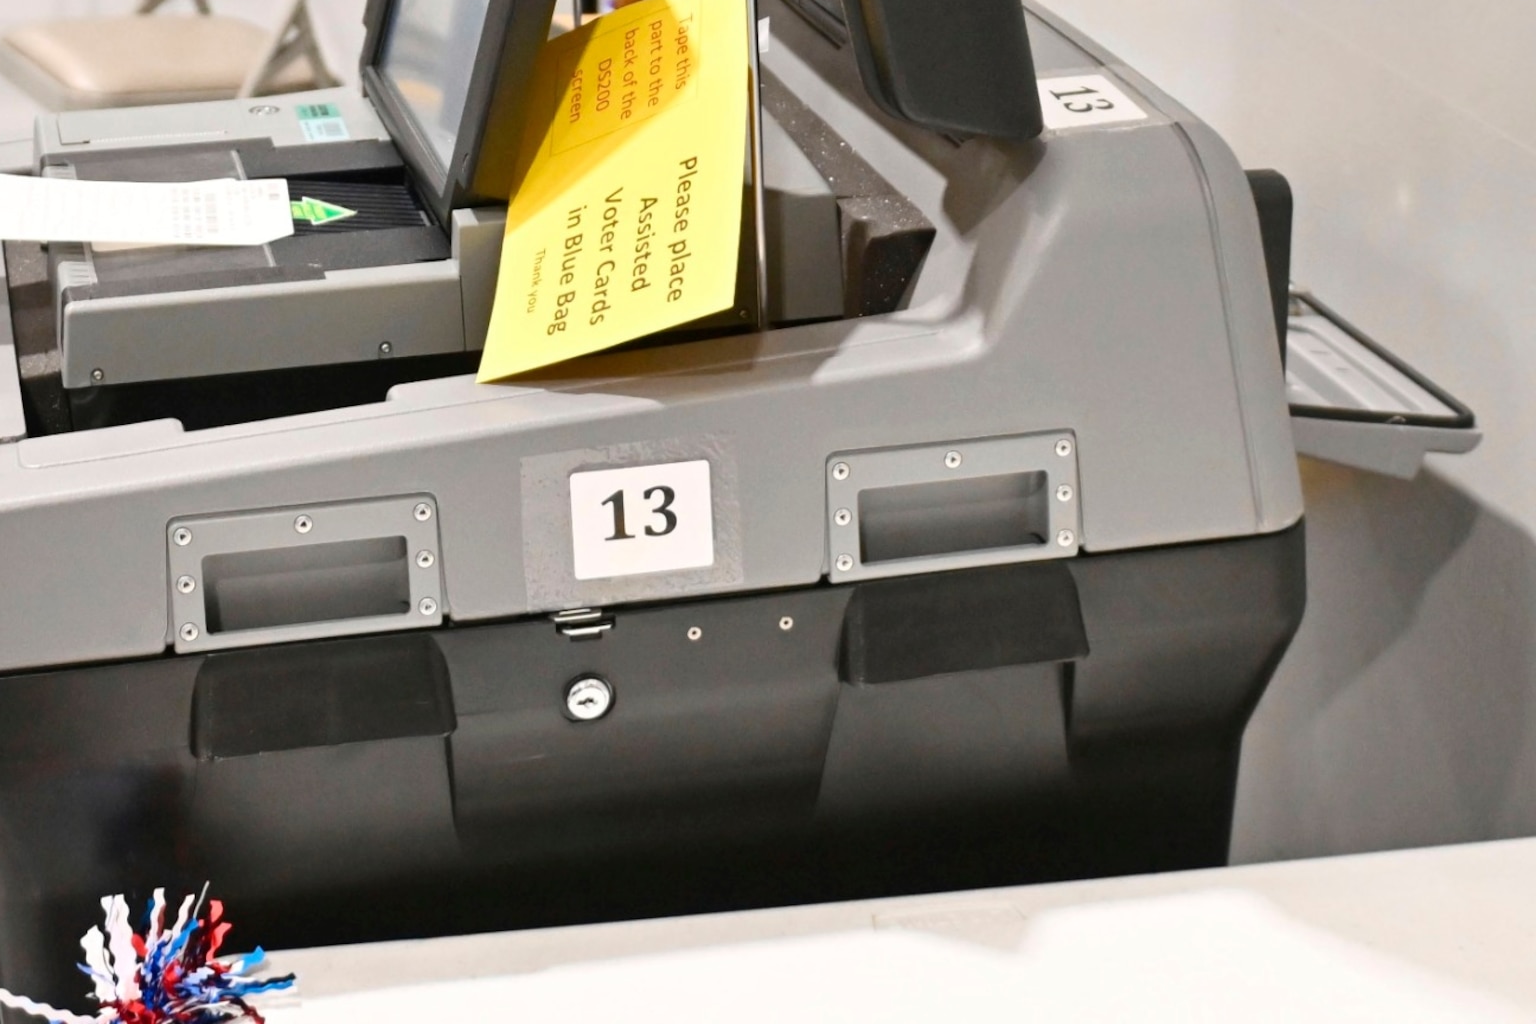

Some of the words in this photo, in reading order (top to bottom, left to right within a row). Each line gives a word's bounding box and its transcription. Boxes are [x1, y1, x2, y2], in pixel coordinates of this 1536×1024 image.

[623, 27, 640, 68] back
[648, 19, 663, 55] part
[674, 12, 693, 56] Tape
[595, 57, 612, 112] DS200
[622, 70, 638, 88] of
[649, 57, 662, 75] to
[675, 59, 691, 90] this
[569, 68, 583, 124] screen
[620, 92, 637, 120] the
[647, 79, 664, 108] the
[1049, 86, 1115, 113] 13
[673, 156, 698, 233] Please
[567, 205, 587, 229] in
[599, 186, 624, 253] Voter
[559, 233, 583, 286] Blue
[631, 197, 658, 292] Assisted
[531, 248, 546, 288] Thank
[667, 239, 692, 302] place
[527, 289, 539, 314] you
[547, 290, 576, 336] Bag
[589, 259, 616, 326] Cards
[600, 484, 678, 542] 13
